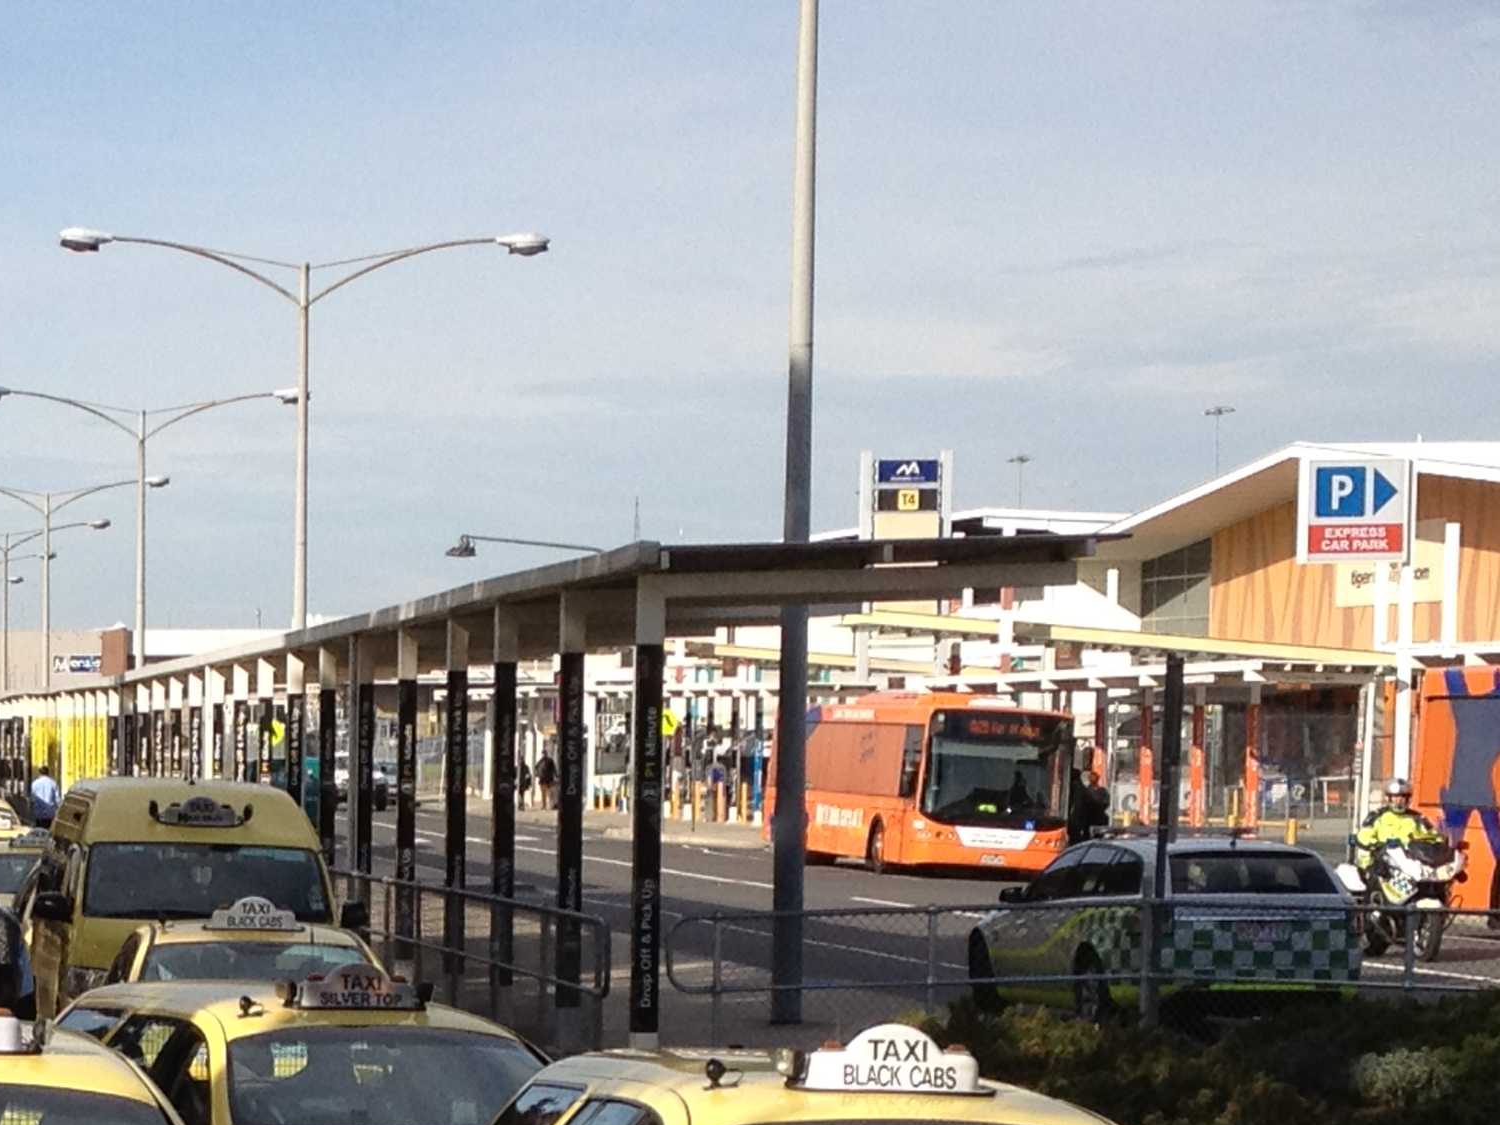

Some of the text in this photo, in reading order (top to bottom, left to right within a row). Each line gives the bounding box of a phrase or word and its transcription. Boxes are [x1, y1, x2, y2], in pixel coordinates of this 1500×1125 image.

[901, 493, 916, 506] T4
[1331, 475, 1354, 510] P
[1323, 527, 1387, 538] EXPRESS
[1321, 539, 1389, 551] CAR PARK
[644, 705, 657, 757] Minute
[641, 879, 655, 899] Up
[240, 902, 271, 914] TAXI
[226, 915, 284, 928] BLACK CABS
[641, 933, 652, 944] &
[640, 948, 652, 971] Off
[339, 974, 383, 991] TAXI
[641, 973, 653, 1008] Drop
[319, 991, 403, 1006] SILVER TOP
[867, 1039, 929, 1063] TAXI
[843, 1064, 958, 1090] BLACK CABS
